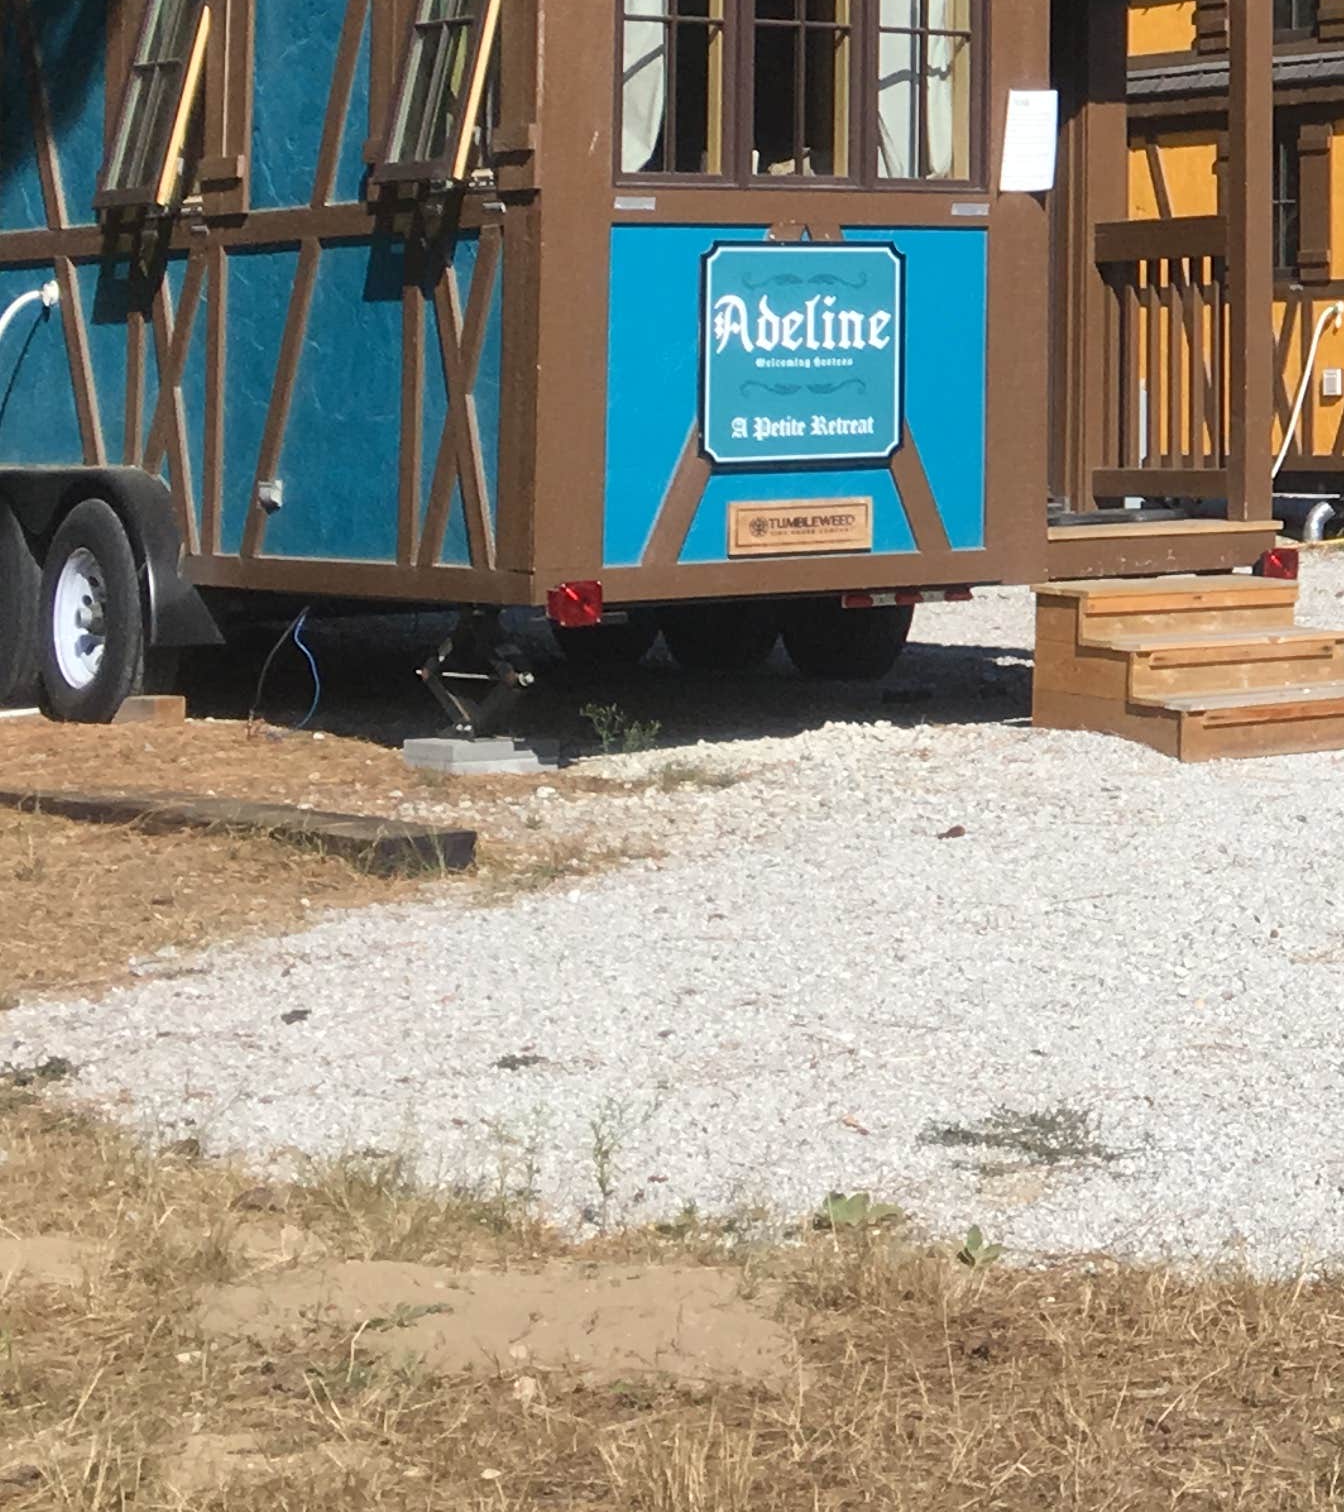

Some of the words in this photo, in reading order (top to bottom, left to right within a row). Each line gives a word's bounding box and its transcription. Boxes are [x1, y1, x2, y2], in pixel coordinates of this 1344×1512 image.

[714, 294, 891, 354] Adeline
[755, 356, 810, 369] Welcoming
[731, 416, 748, 438] A
[753, 416, 805, 441] Petite
[810, 414, 874, 436] Retreat
[768, 514, 855, 529] TUMBLEWEED
